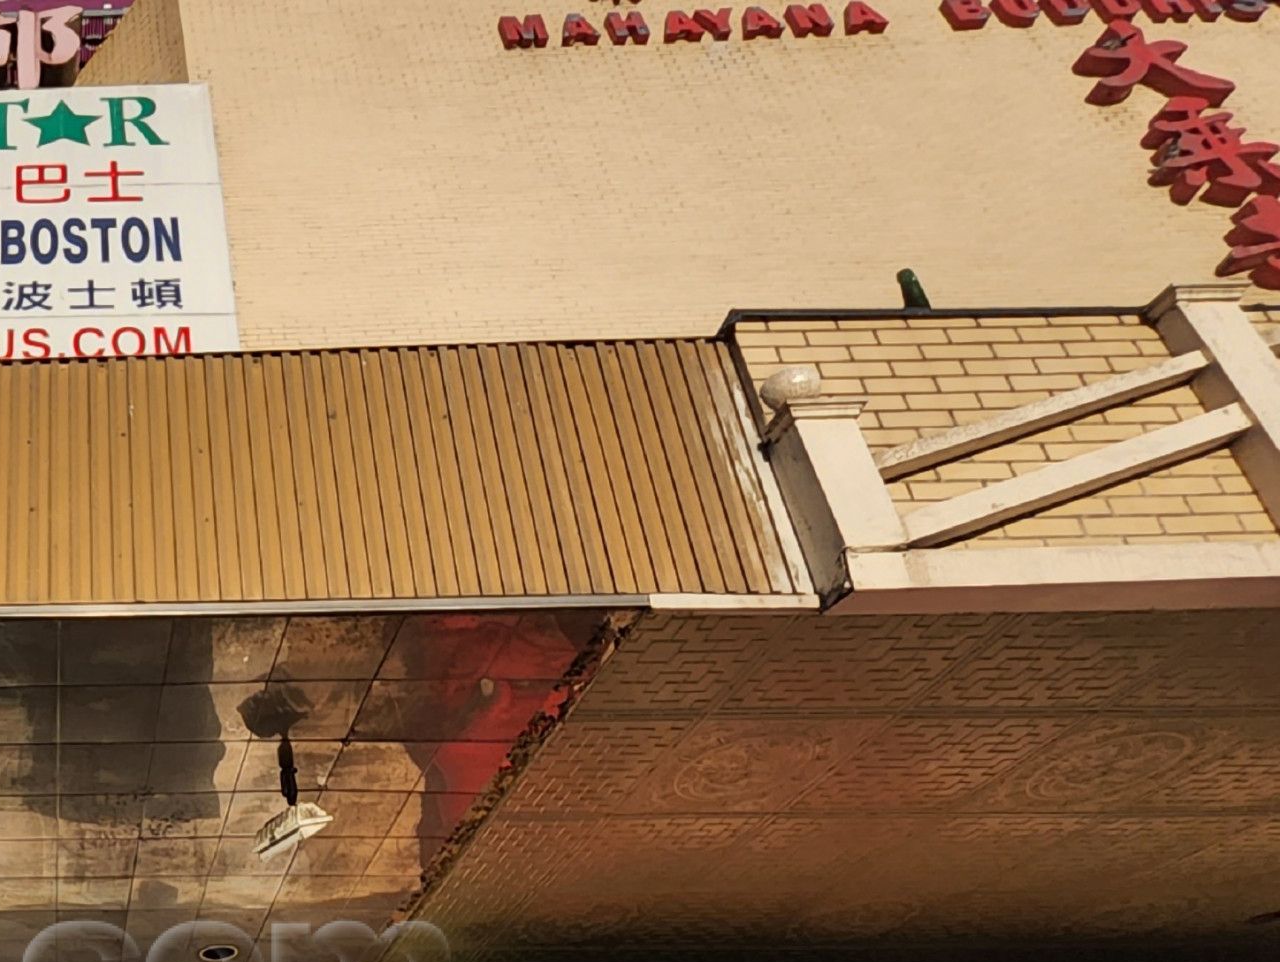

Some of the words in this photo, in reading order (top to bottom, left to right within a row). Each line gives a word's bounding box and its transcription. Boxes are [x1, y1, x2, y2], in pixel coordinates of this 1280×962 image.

[497, 1, 889, 49] MAHAYANA
[1, 218, 181, 264] BOSTON
[3, 278, 184, 311] 波士頓
